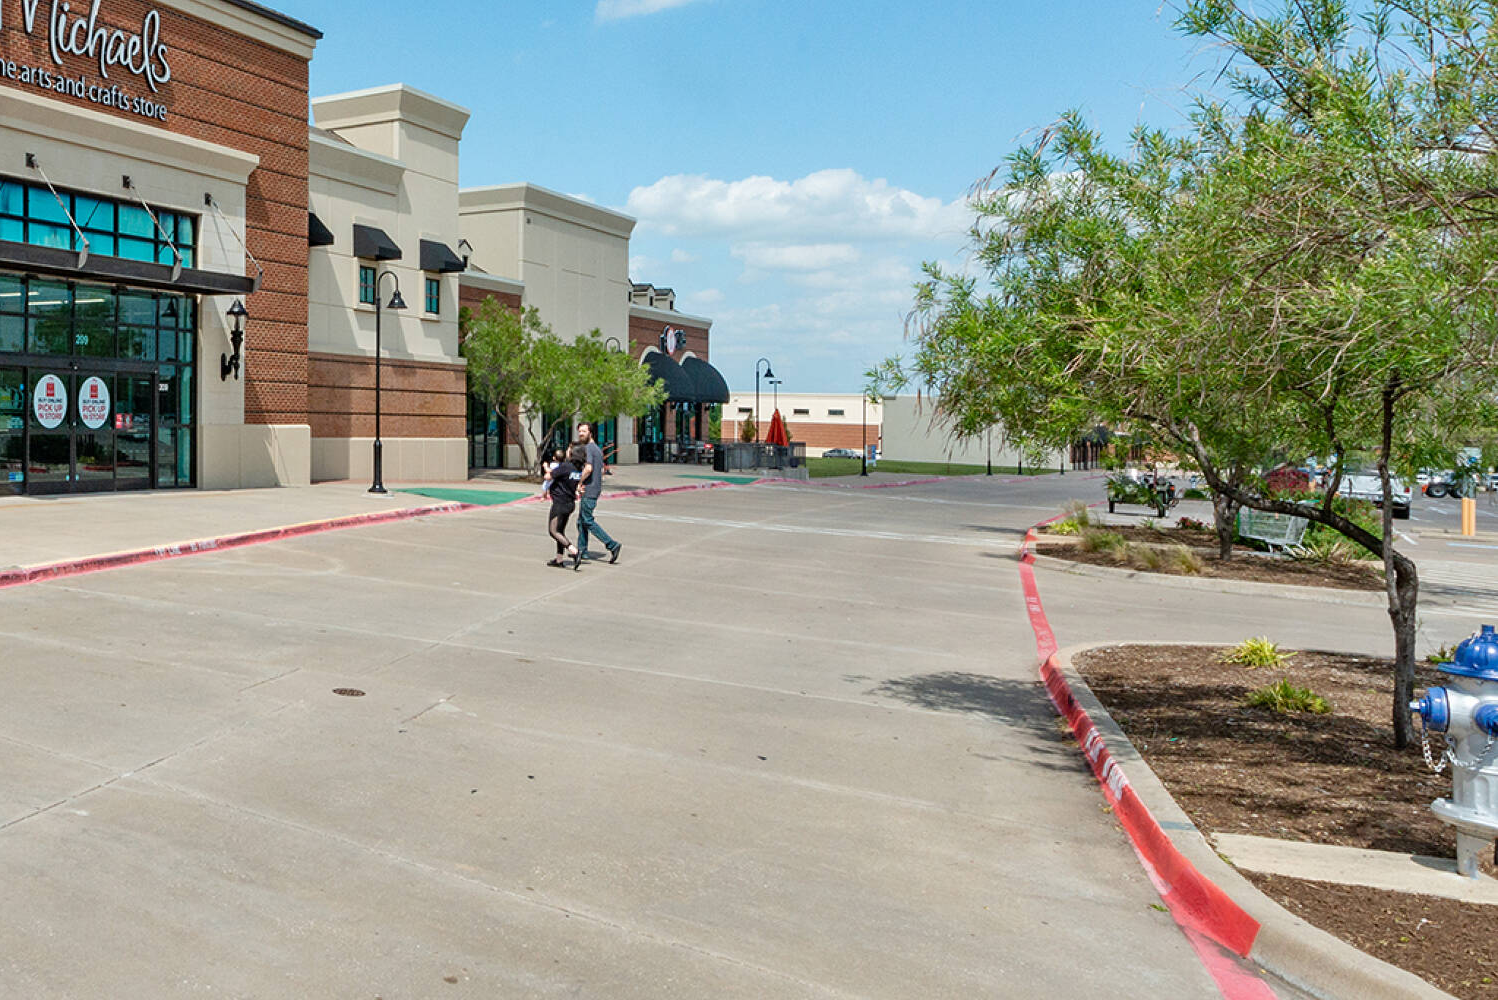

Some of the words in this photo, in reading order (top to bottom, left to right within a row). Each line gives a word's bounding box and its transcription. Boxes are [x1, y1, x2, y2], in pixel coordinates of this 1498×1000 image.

[21, 65, 52, 89] arts
[56, 76, 86, 99] and
[89, 85, 130, 111] crafts
[133, 95, 168, 121] store
[54, 404, 63, 412] UP
[82, 405, 96, 413] PICK
